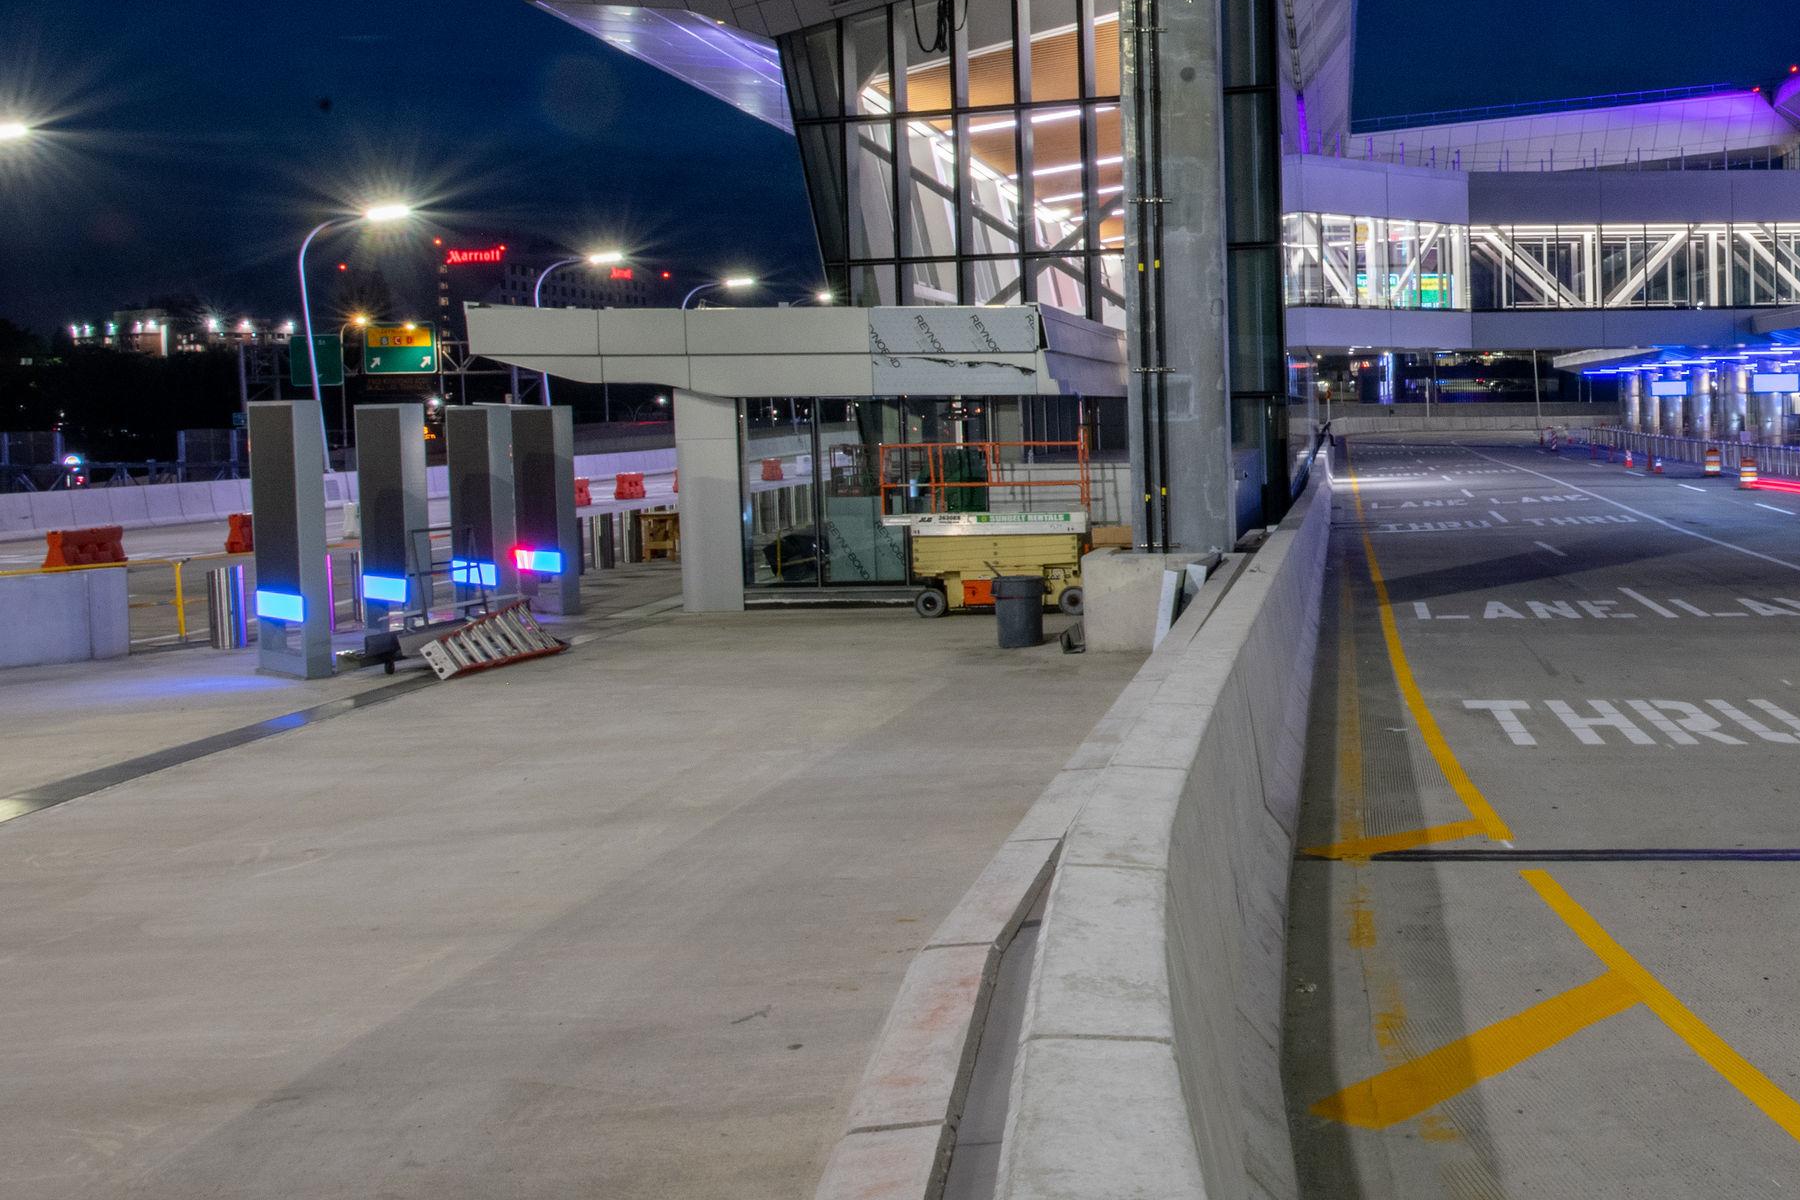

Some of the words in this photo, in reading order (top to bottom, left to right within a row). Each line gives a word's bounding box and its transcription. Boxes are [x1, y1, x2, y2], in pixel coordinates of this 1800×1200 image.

[446, 248, 502, 264] Marriott
[1371, 499, 1470, 510] LANE
[1490, 494, 1593, 505] LANE
[1378, 519, 1494, 533] THRU
[1521, 514, 1638, 528] THRU
[1413, 599, 1638, 620] LANE
